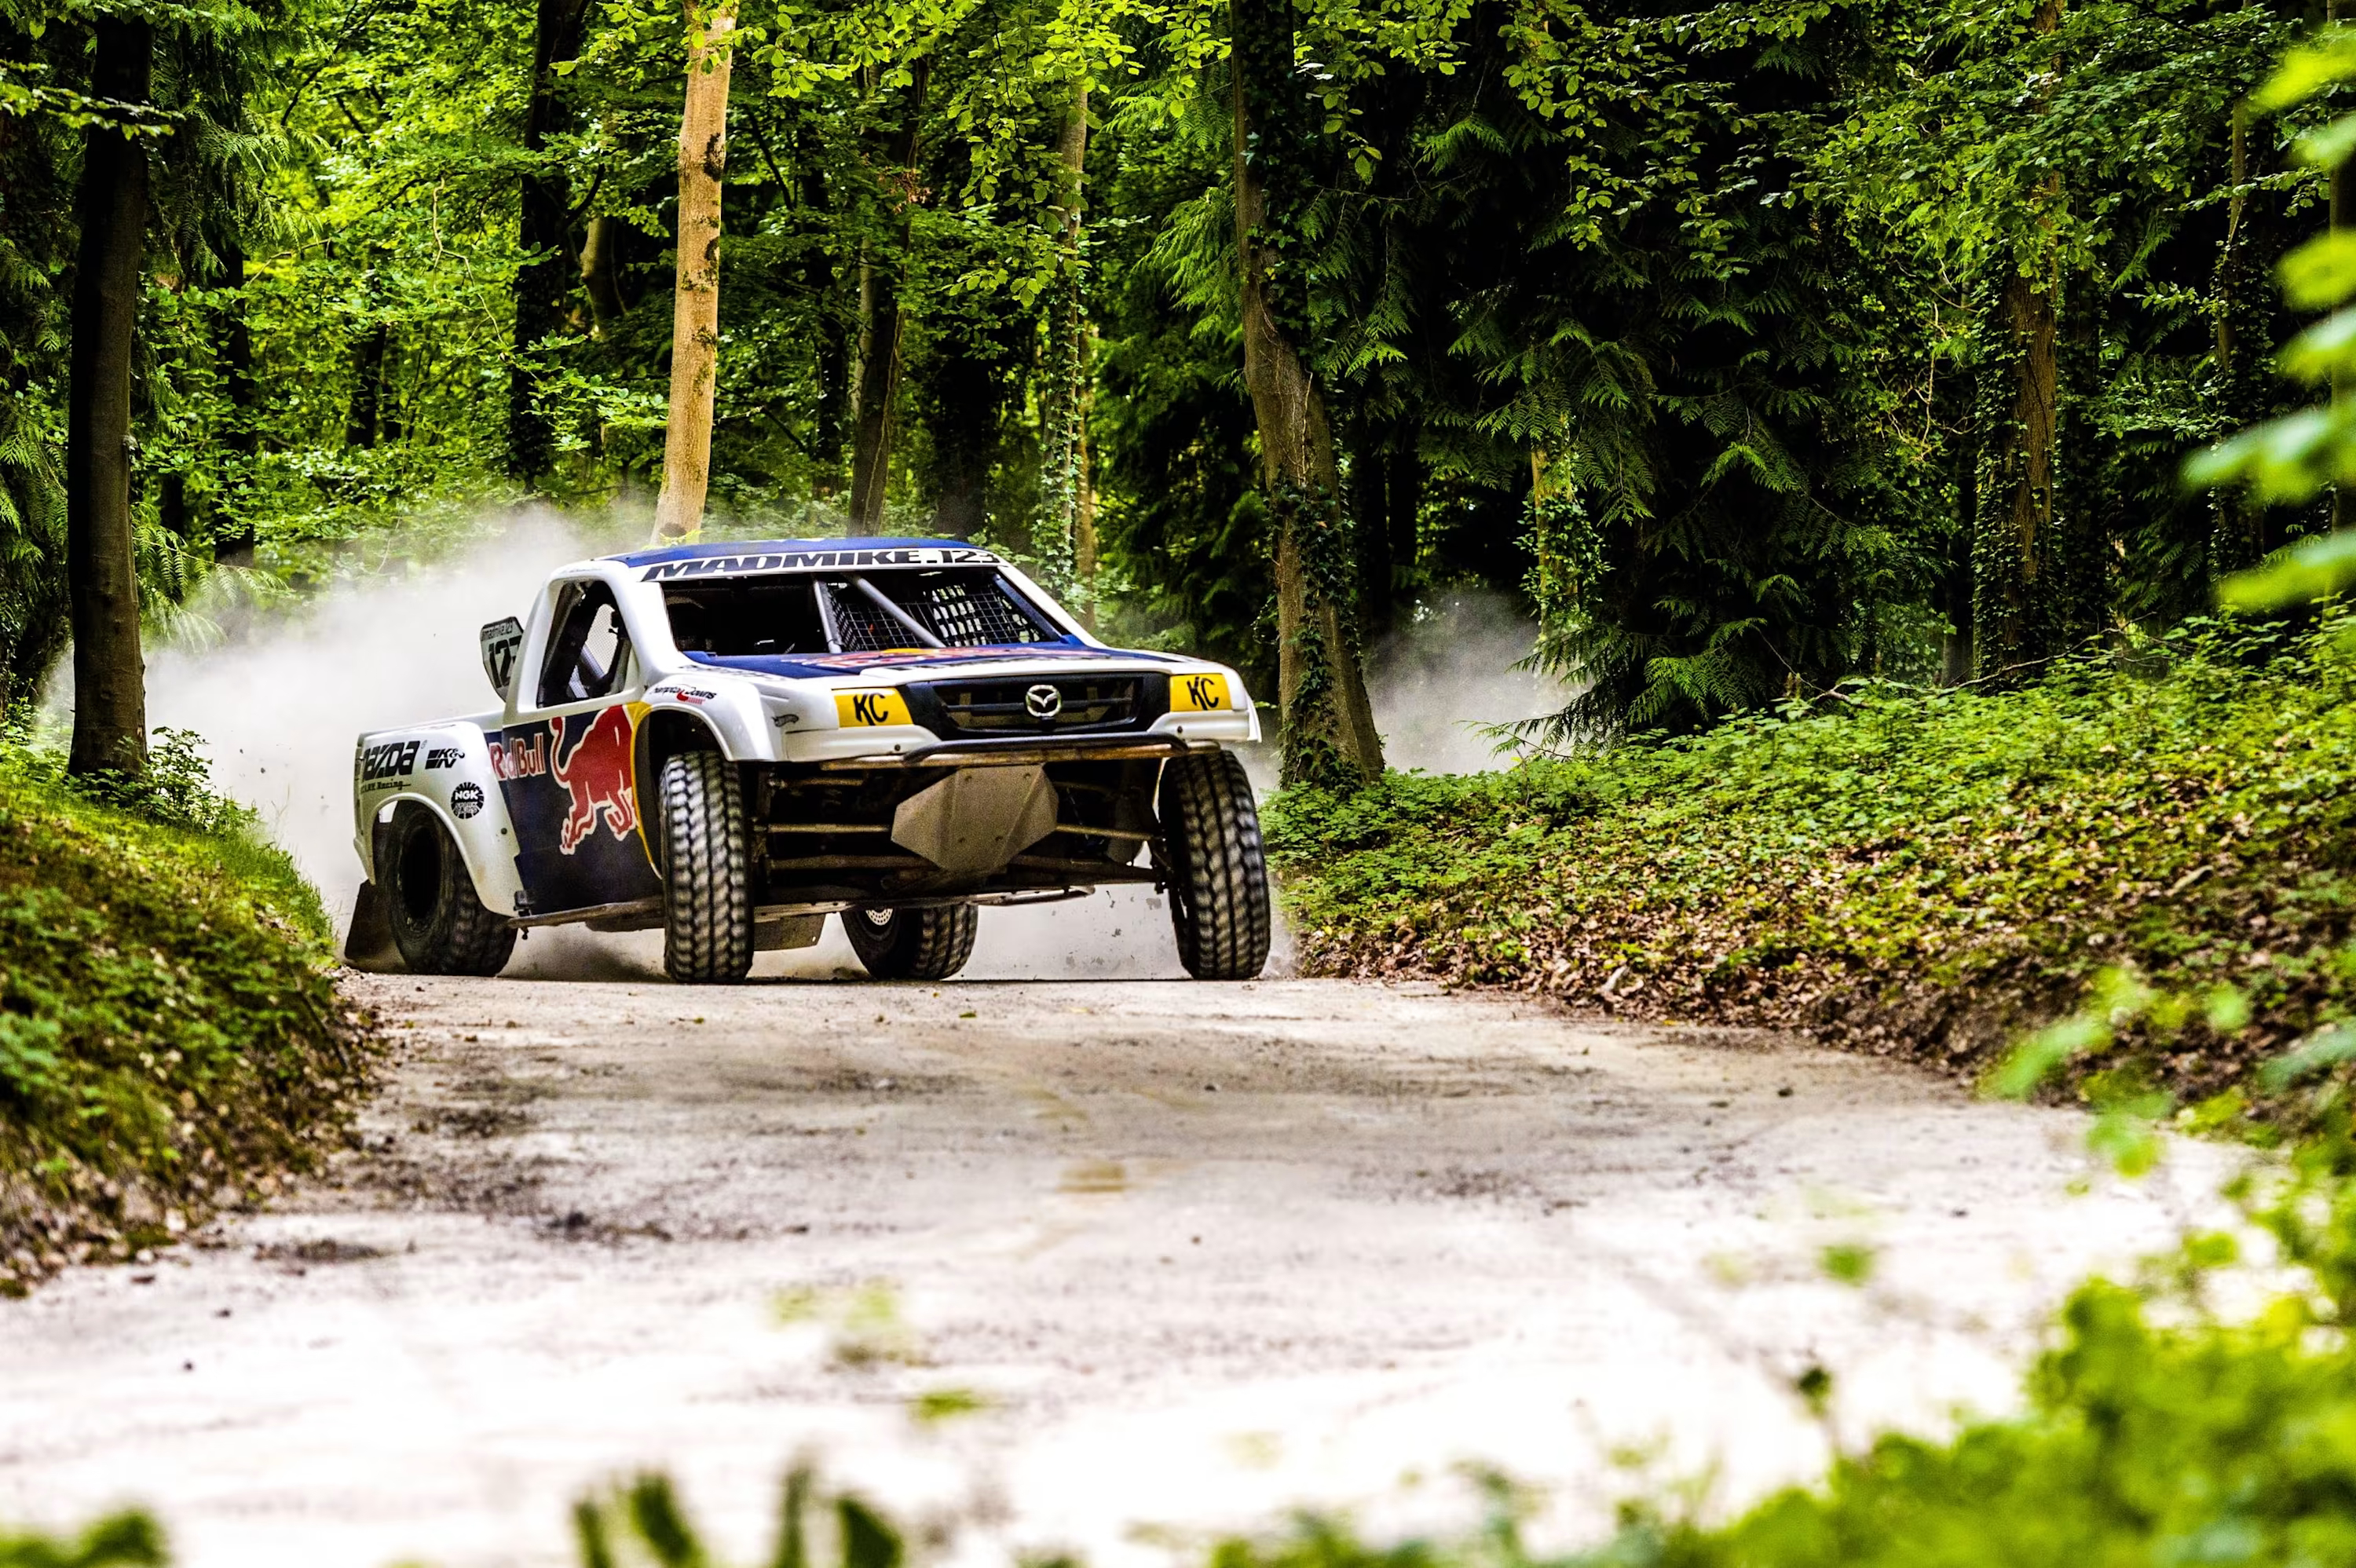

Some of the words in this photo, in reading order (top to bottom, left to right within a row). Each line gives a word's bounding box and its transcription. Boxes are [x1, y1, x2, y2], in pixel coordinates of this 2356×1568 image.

[853, 693, 888, 726] KC
[1187, 677, 1219, 711] KC
[515, 732, 546, 777] Bull
[455, 789, 479, 800] NGK
